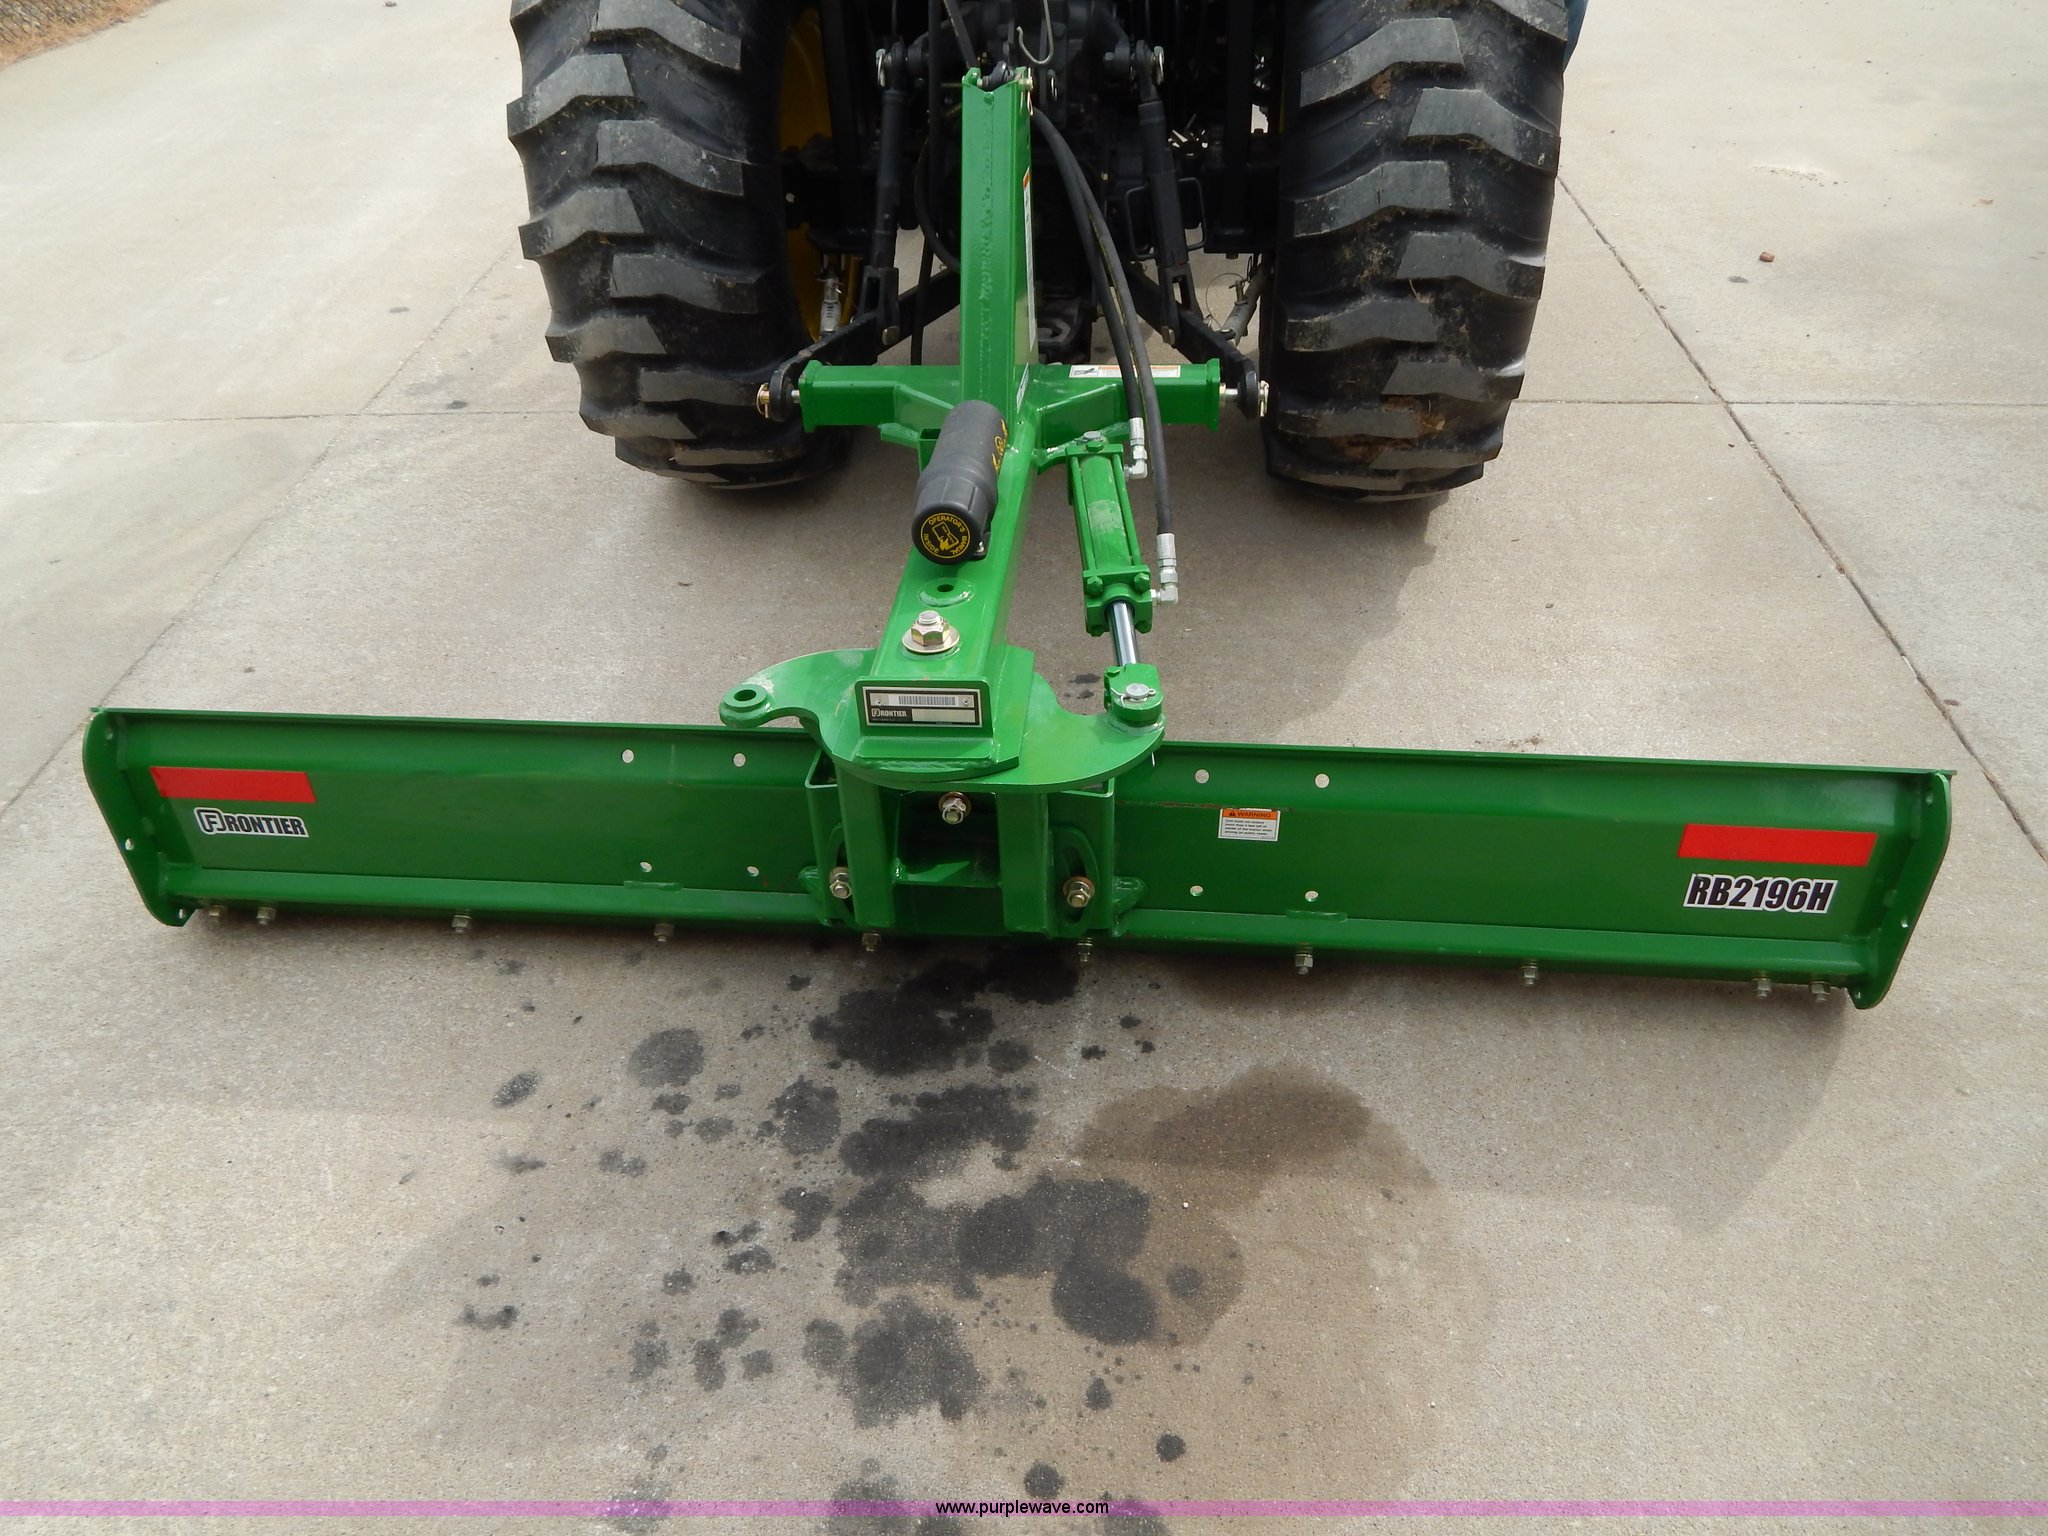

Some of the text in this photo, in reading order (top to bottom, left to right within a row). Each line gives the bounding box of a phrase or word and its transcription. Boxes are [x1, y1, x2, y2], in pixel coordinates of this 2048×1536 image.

[871, 708, 907, 718] FRONTIER
[196, 808, 306, 836] FRONTIER
[1686, 875, 1834, 912] RB2196H
